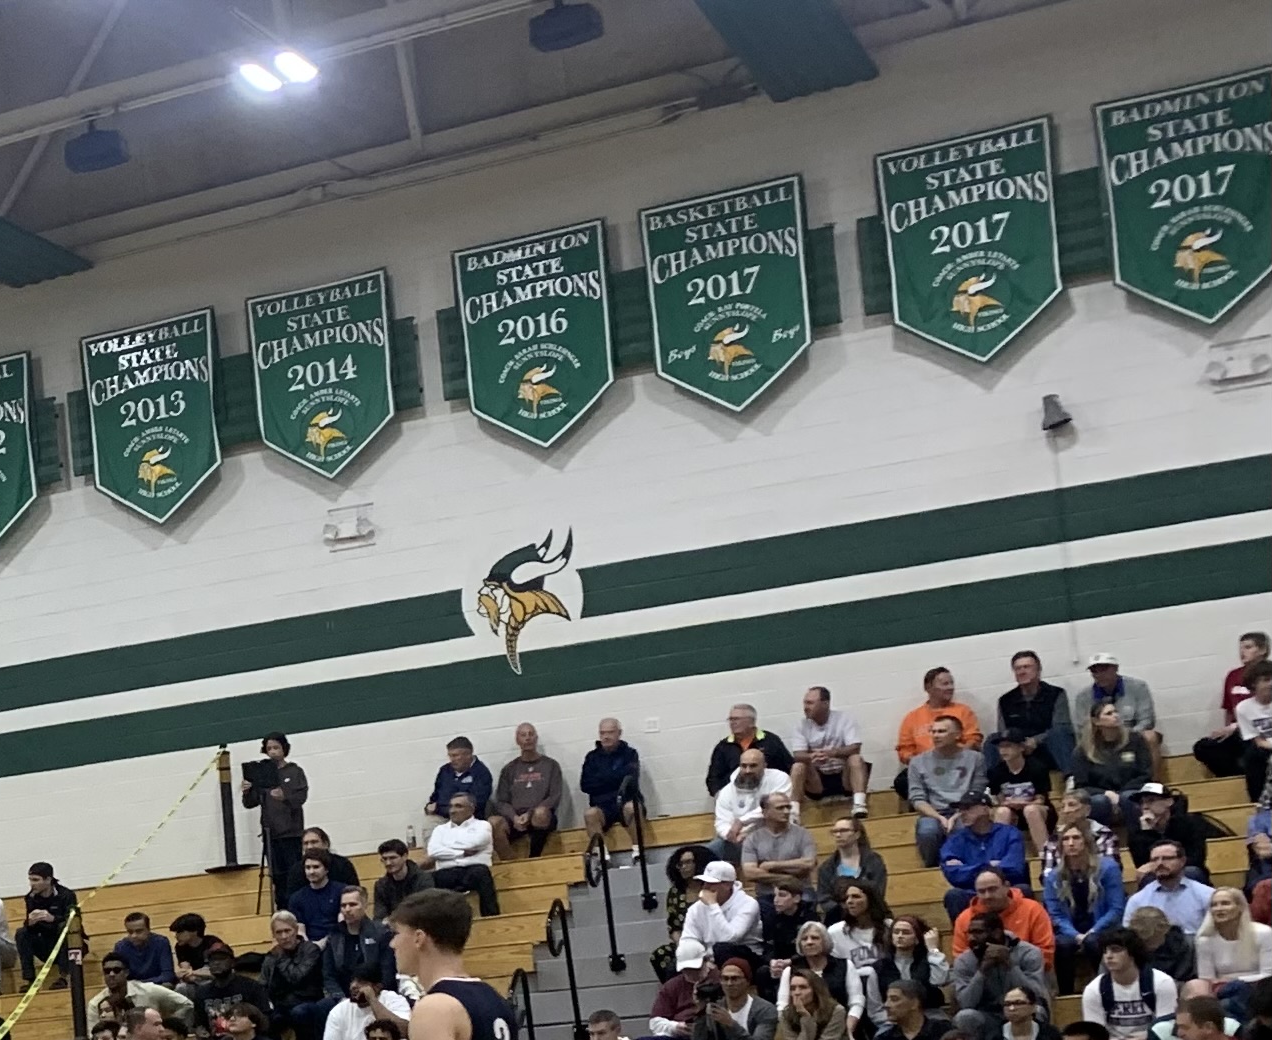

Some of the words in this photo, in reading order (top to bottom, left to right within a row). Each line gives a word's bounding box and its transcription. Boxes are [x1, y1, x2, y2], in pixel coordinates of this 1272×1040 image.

[1109, 79, 1265, 127] BADMINTON
[1147, 107, 1233, 141] STATE
[885, 128, 1040, 175] VOLLEYBALL
[925, 158, 1006, 190] STATE
[1148, 163, 1236, 209] 2017
[649, 186, 792, 231] BASKETBALL
[890, 171, 1048, 233] CHAMPIONS
[685, 212, 759, 243] STATE
[929, 211, 1011, 255] 2017
[467, 230, 591, 272] BADMINTON
[496, 257, 564, 286] STATE
[652, 226, 796, 284] CHAMPIONS
[256, 279, 378, 318] VOLLEYBALL
[465, 270, 601, 325] CHAMPIONS
[686, 264, 761, 306] 2017
[88, 319, 205, 356] VOLLEYBALL
[286, 305, 351, 333] STATE
[497, 307, 568, 346] 2016
[118, 343, 178, 371] STATE
[258, 317, 384, 370] CHAMPIONS
[91, 355, 209, 407] CHAMPIONS
[287, 353, 358, 392] 2014
[120, 390, 186, 427] 2013
